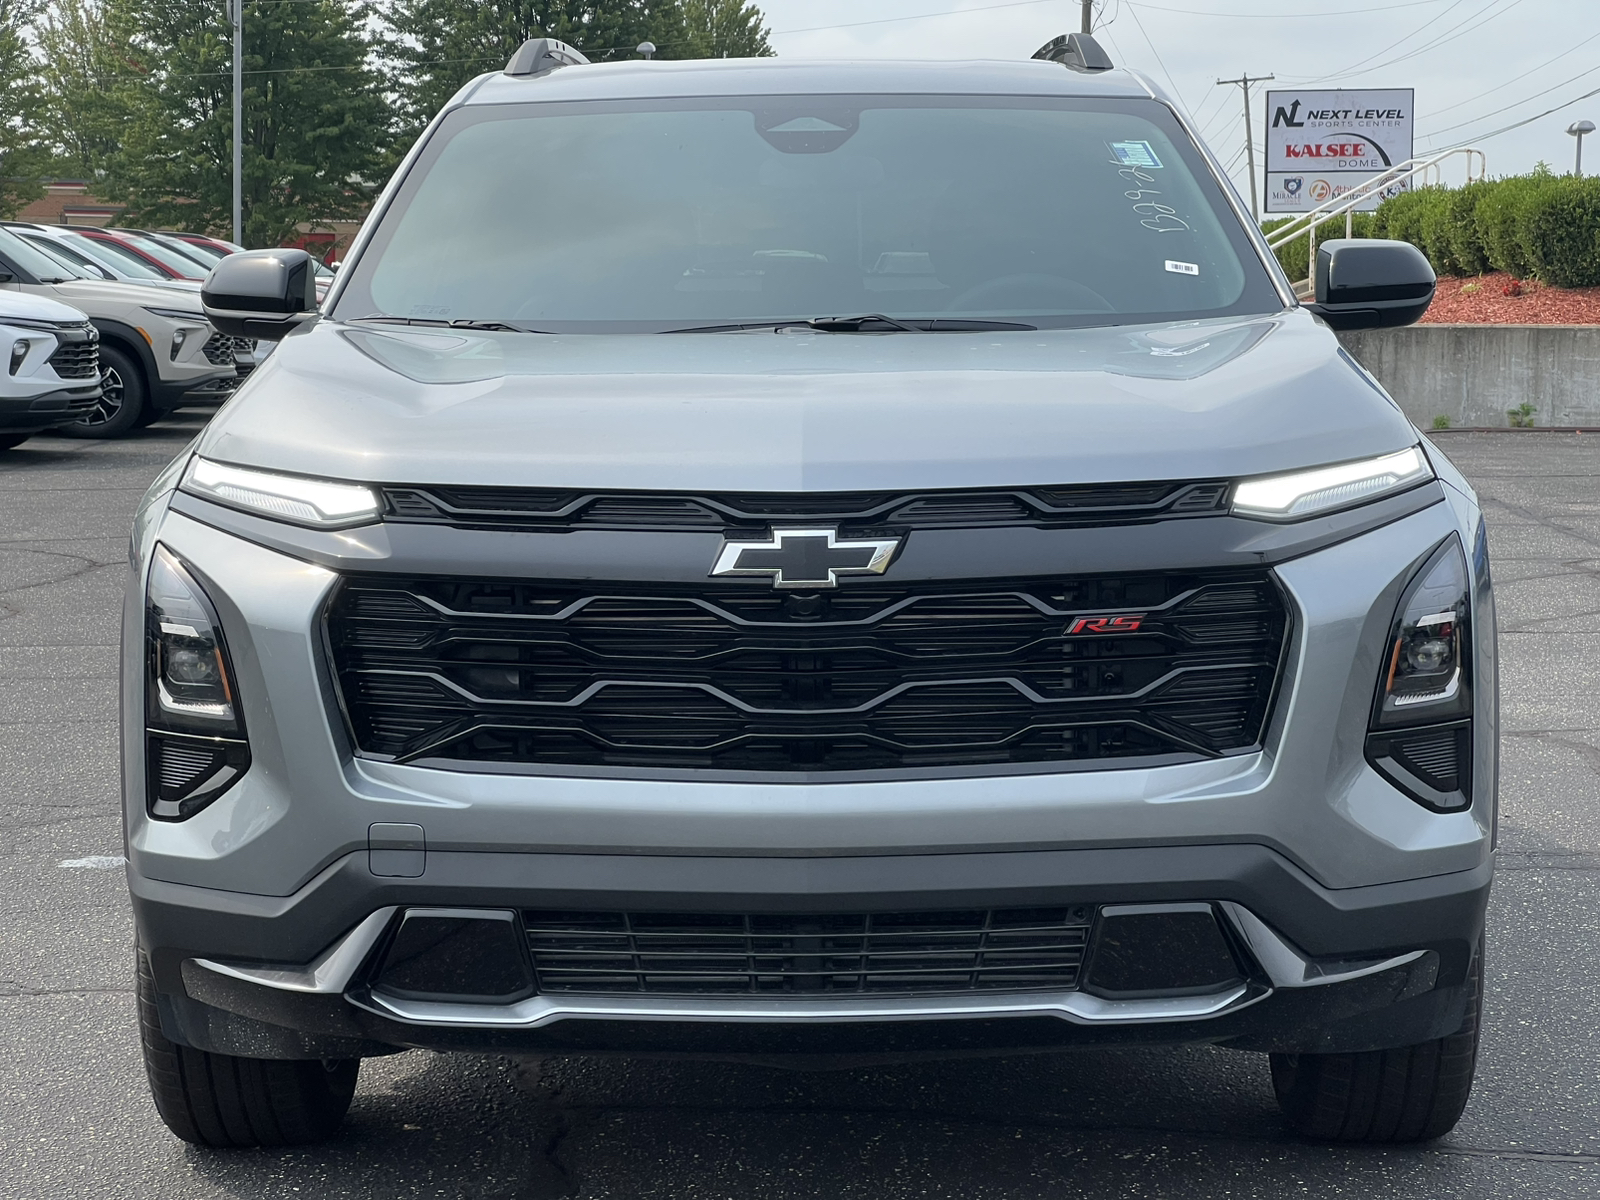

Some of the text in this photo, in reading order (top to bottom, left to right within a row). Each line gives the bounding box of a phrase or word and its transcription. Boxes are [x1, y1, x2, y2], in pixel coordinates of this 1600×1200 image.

[1307, 109, 1404, 120] NEXT LEVEL
[1285, 144, 1366, 158] KALSEE
[1338, 159, 1378, 167] DOME
[1072, 616, 1144, 634] RS
